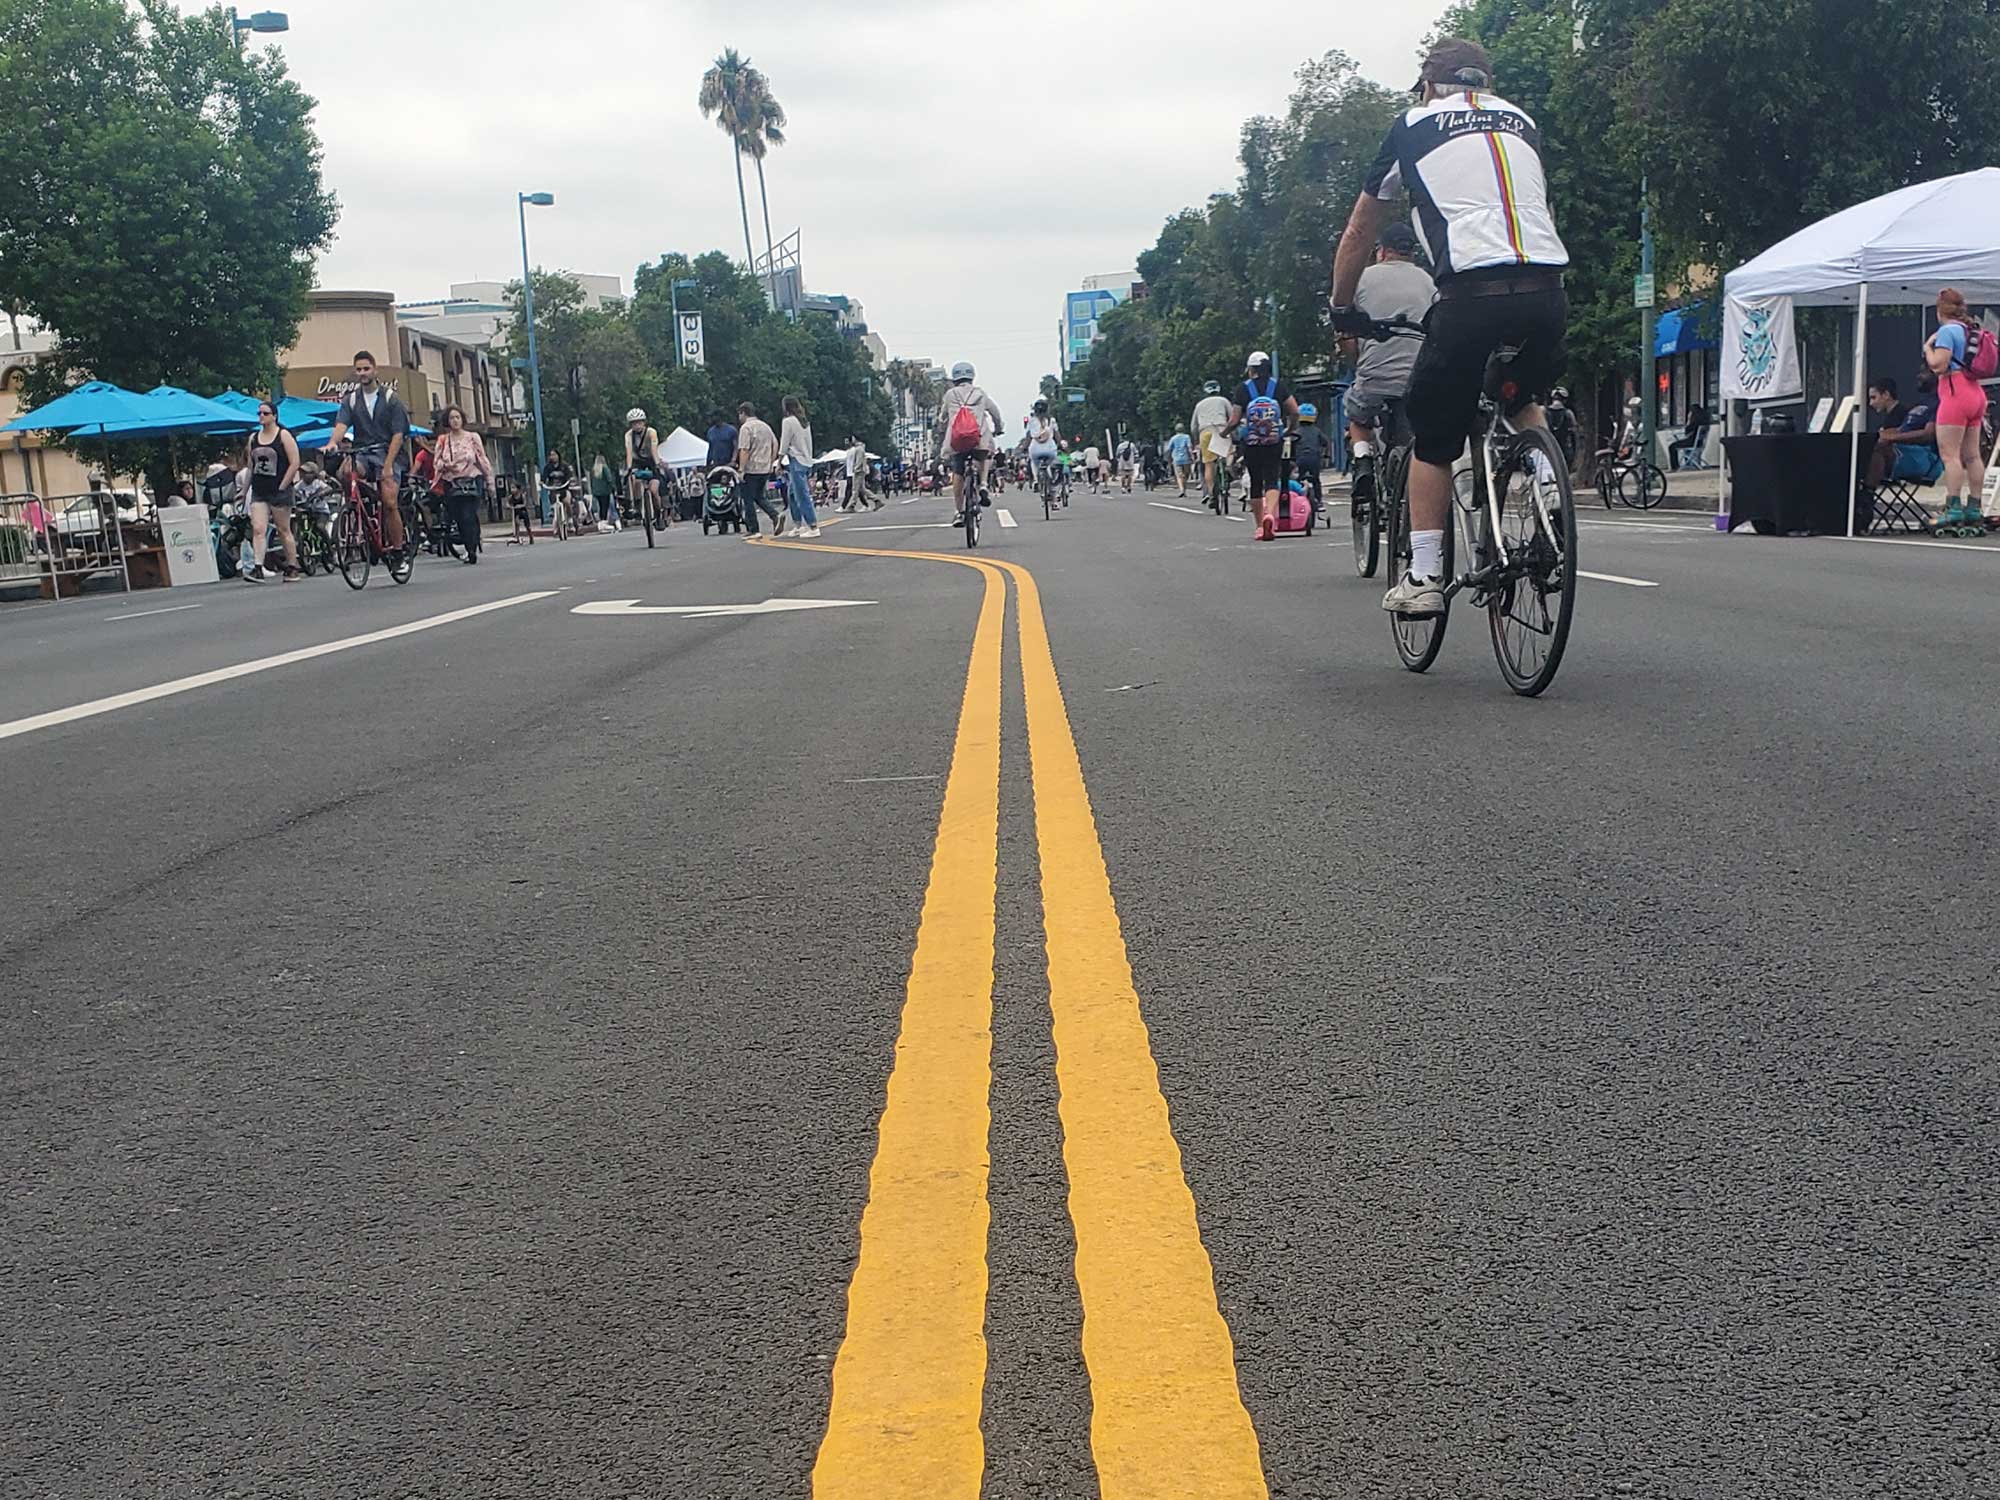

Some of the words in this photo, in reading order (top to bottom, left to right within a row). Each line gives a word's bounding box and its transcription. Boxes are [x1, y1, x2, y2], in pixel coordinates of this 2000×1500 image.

[1435, 111, 1493, 131] Nalini
[685, 316, 697, 329] N
[687, 341, 698, 353] H
